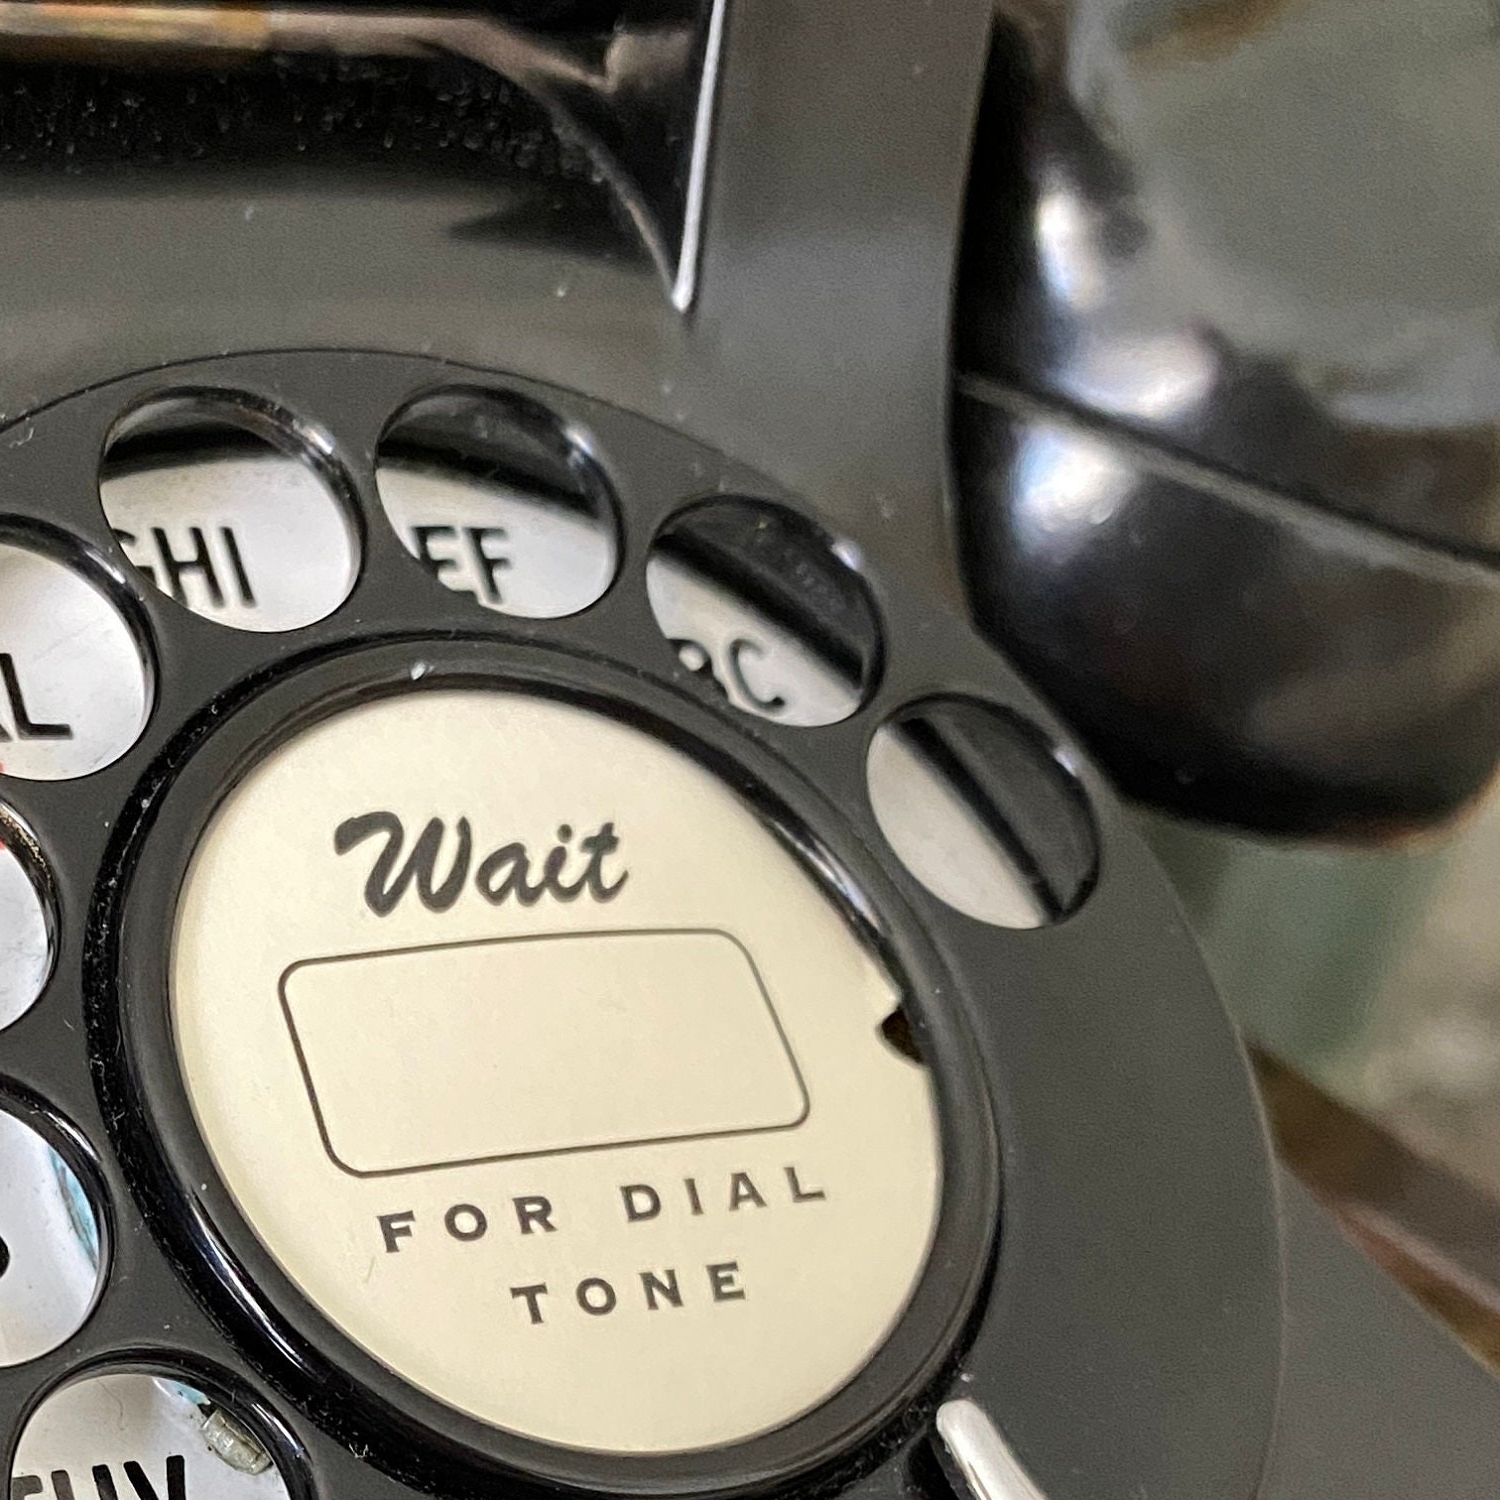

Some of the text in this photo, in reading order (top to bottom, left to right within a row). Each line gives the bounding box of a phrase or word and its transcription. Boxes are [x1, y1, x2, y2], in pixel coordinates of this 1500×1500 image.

[334, 811, 629, 917] Wait
[377, 1166, 827, 1253] FOR DIAL
[510, 1262, 746, 1325] TONE
